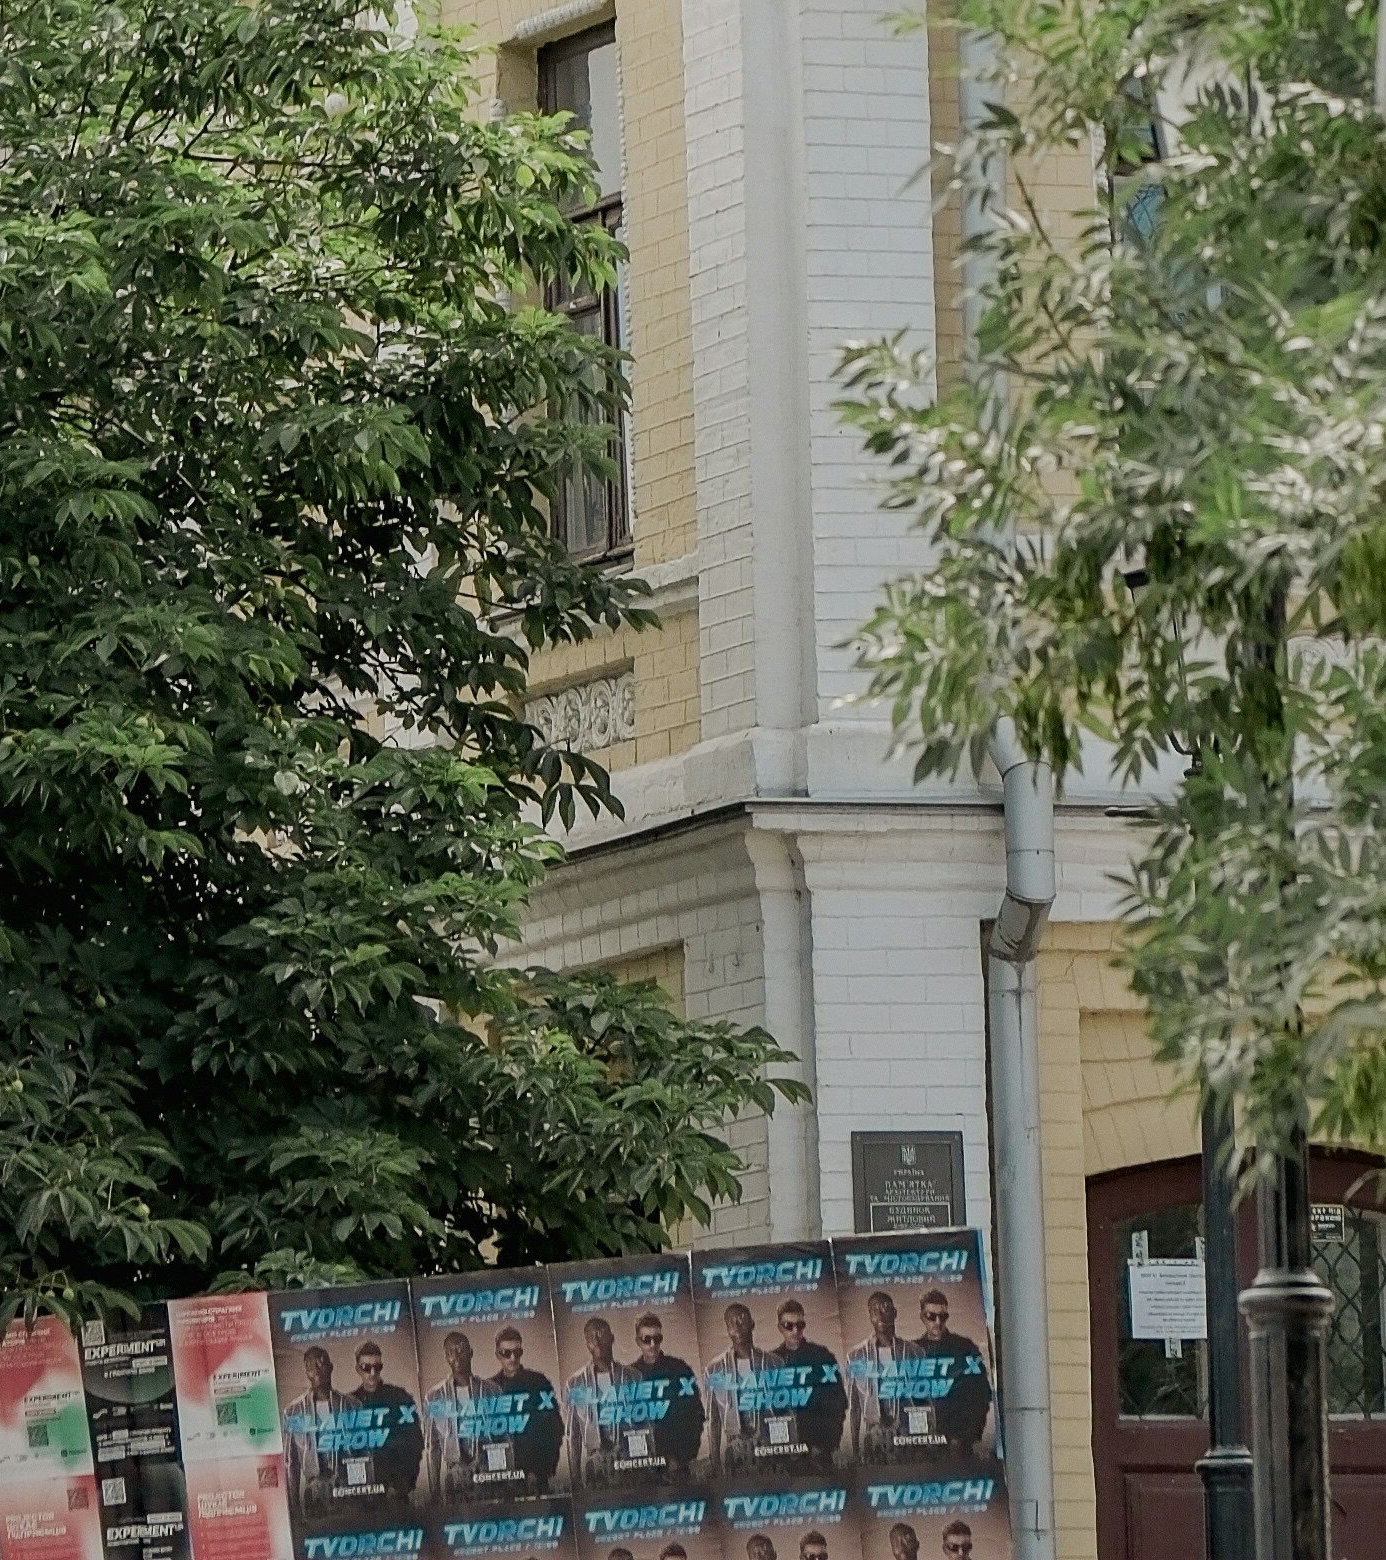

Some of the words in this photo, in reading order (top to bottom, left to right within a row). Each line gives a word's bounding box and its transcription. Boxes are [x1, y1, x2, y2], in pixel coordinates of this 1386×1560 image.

[889, 1206, 931, 1215] БУДИНОК
[701, 1258, 823, 1288] TVORCHI
[844, 1250, 968, 1275] TVORCHI
[420, 1285, 540, 1317] TVORCHI
[561, 1271, 680, 1303] TVORCHI
[281, 1300, 401, 1332] TVORCHI
[705, 1366, 813, 1391] PLANET
[821, 1363, 838, 1384] X
[847, 1356, 955, 1379] PLANET
[964, 1356, 982, 1375] X
[567, 1377, 670, 1405] PLANET
[678, 1376, 695, 1397] X
[738, 1386, 813, 1412] SHOW
[878, 1378, 954, 1400] SHOW
[285, 1407, 390, 1431] PLANET
[398, 1405, 416, 1424] X
[426, 1392, 530, 1418] PLANET
[538, 1390, 555, 1411] X
[598, 1399, 670, 1426] SHOW
[458, 1413, 530, 1439] SHOW
[317, 1428, 390, 1453] SHOW
[723, 1489, 847, 1519] TVORCHI
[866, 1479, 993, 1507] TVORCHI
[443, 1515, 564, 1546] TVORCHI
[584, 1500, 705, 1533] TVORCHI
[303, 1528, 423, 1560] TVORCHI
